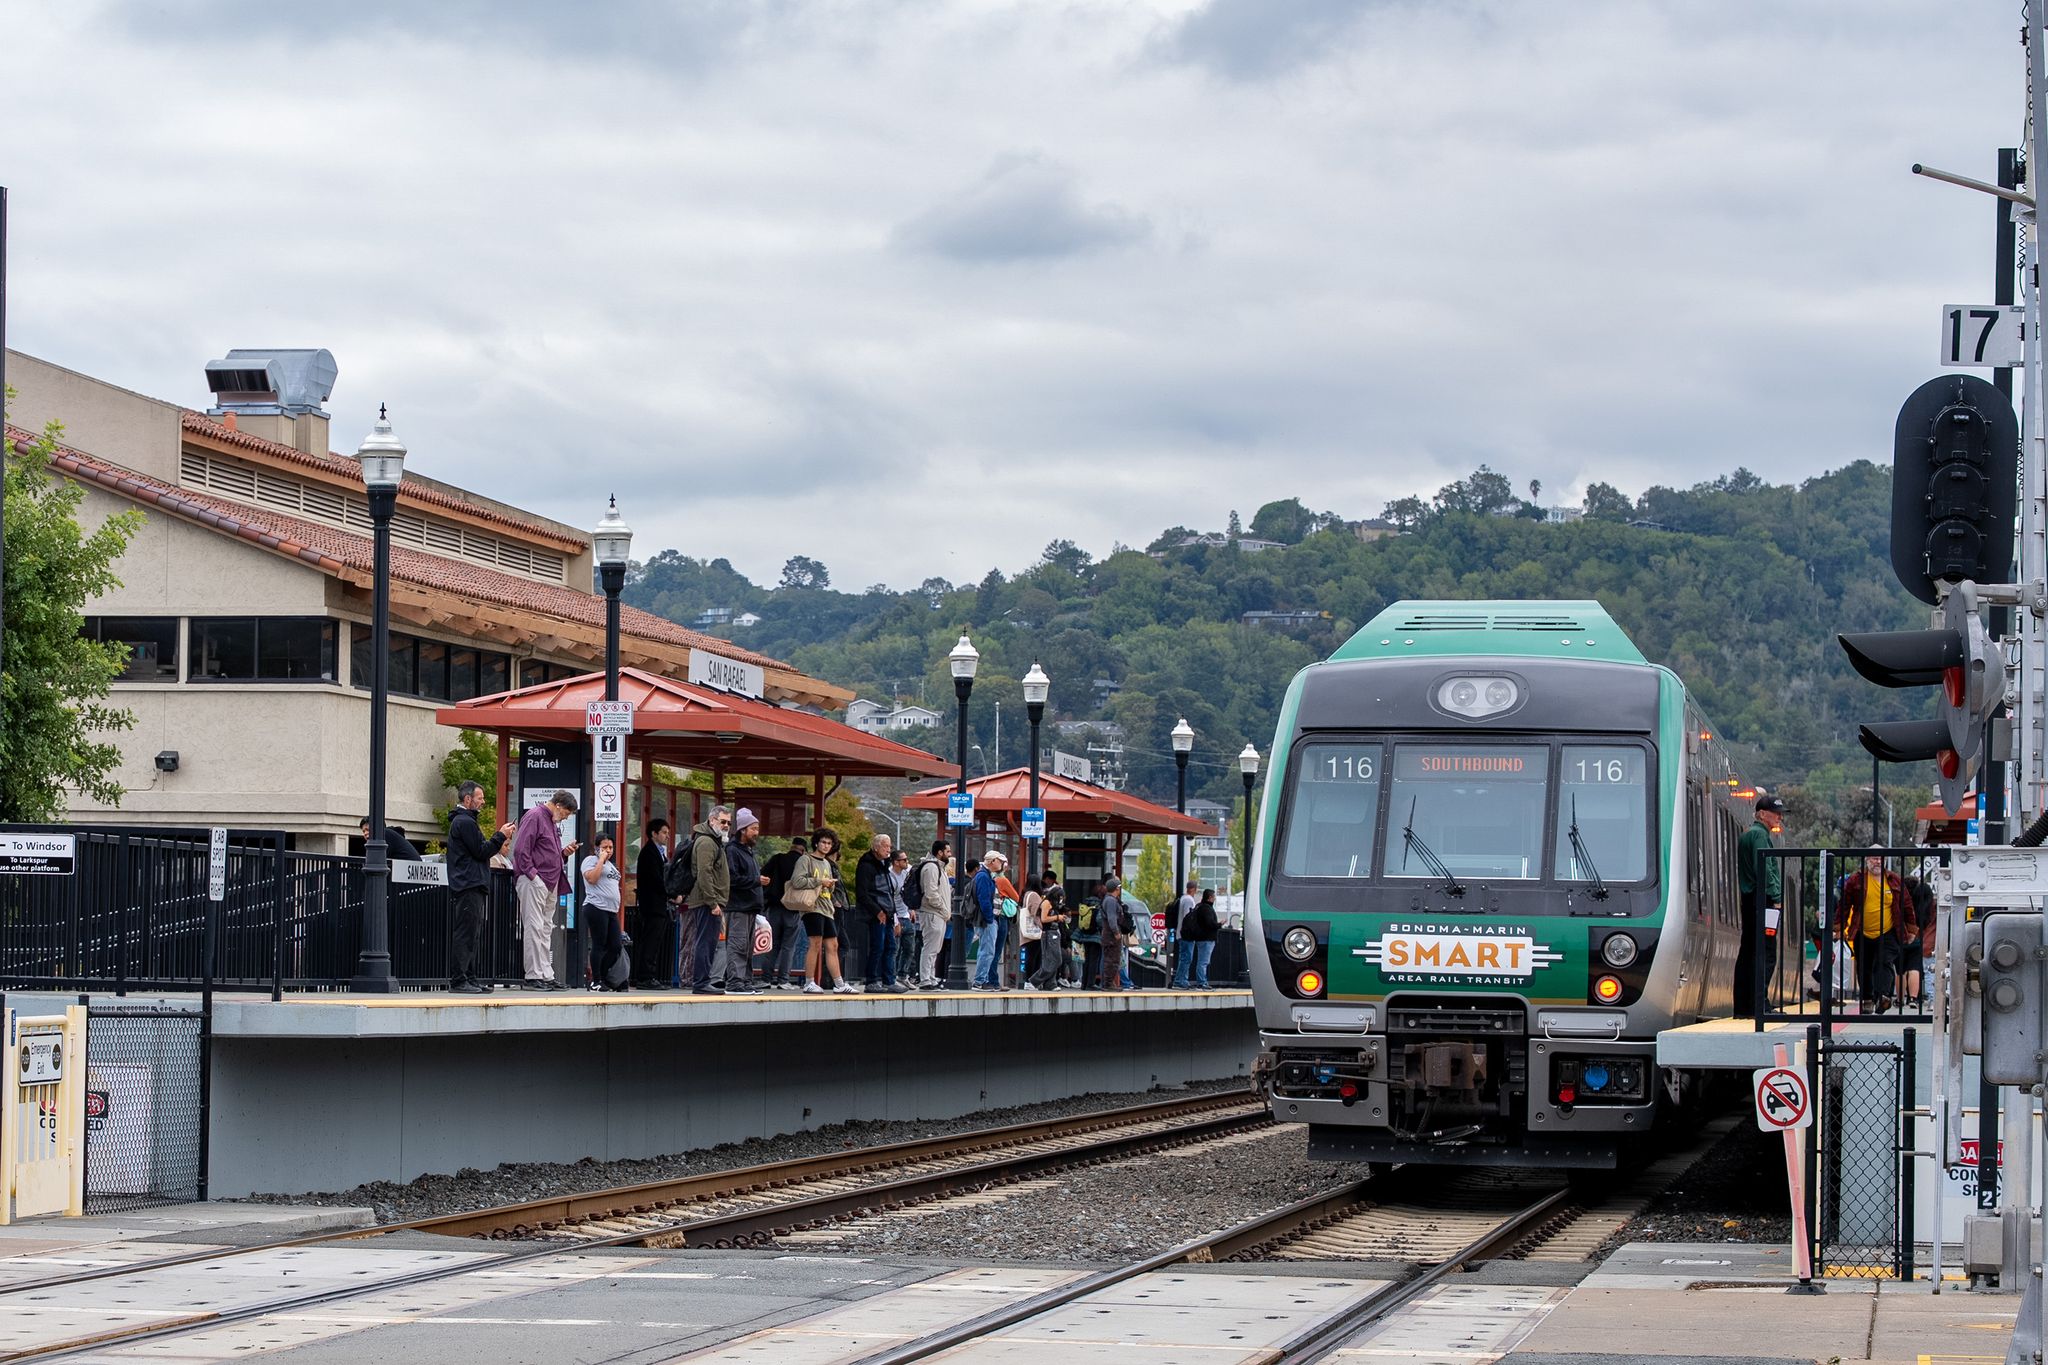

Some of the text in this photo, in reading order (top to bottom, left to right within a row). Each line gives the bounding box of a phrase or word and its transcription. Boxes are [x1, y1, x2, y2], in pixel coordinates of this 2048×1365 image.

[1949, 309, 1999, 362] 17
[708, 660, 746, 691] SAN RAFAEL
[589, 713, 602, 726] NO
[527, 746, 546, 756] San
[527, 758, 559, 769] Rafael
[1327, 756, 1373, 779] 116
[1421, 757, 1524, 772] SOUTHBOUND
[1576, 759, 1623, 782] 116
[215, 830, 225, 844] CAB
[12, 842, 66, 851] To Windsor
[19, 857, 48, 865] Larkspur
[212, 847, 225, 862] SPOT
[30, 865, 60, 873] platform
[211, 865, 224, 879] DOOR
[407, 865, 440, 881] SAN RAFAEL
[210, 883, 224, 897] RIGHT
[1151, 918, 1165, 927] STO
[1388, 940, 1526, 969] SMART
[1430, 975, 1460, 983] RAIL
[1467, 976, 1524, 985] TRANSIT
[31, 1042, 51, 1057] Emergency
[1982, 1191, 1993, 1206] 2
